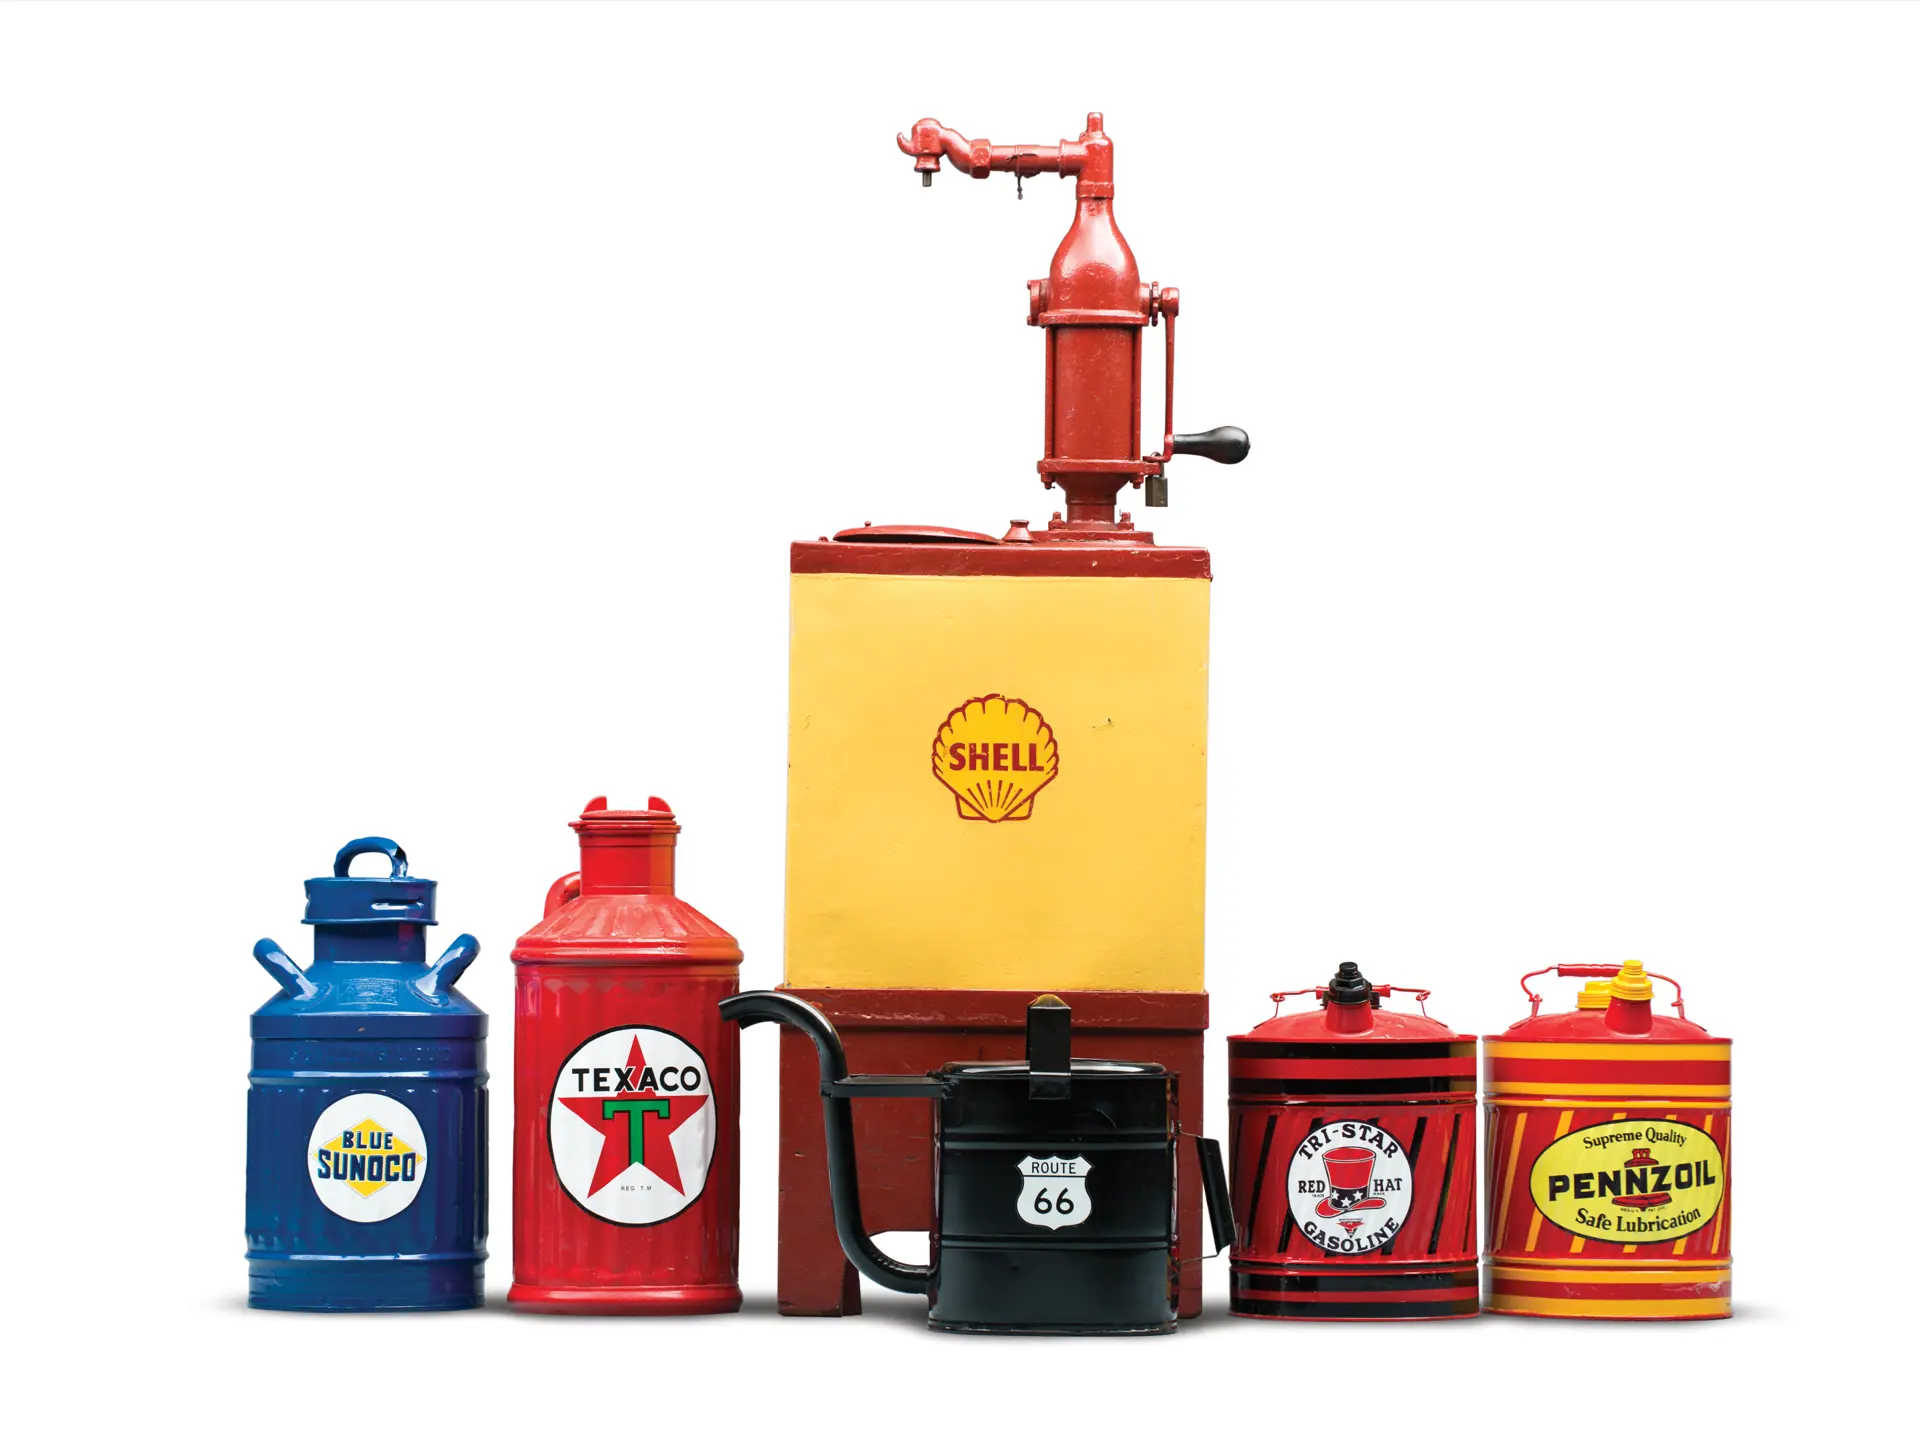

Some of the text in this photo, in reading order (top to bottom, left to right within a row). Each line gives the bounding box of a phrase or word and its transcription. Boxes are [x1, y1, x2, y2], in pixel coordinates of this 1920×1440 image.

[949, 742, 1045, 772] SHELL
[571, 1065, 701, 1092] TEXACO
[341, 1130, 394, 1150] BLUE
[602, 1098, 671, 1167] T
[1298, 1123, 1399, 1161] TRI-STAR
[1583, 1126, 1688, 1150] Supreme Quality
[317, 1148, 417, 1182] SUNOCO
[1031, 1161, 1077, 1175] ROUTE
[1298, 1177, 1403, 1194] RED HAT
[1548, 1159, 1716, 1202] PENNZOIL
[1033, 1186, 1075, 1215] 66
[1303, 1216, 1400, 1252] GASOLINE
[1575, 1207, 1702, 1233] Safe Lubrication
